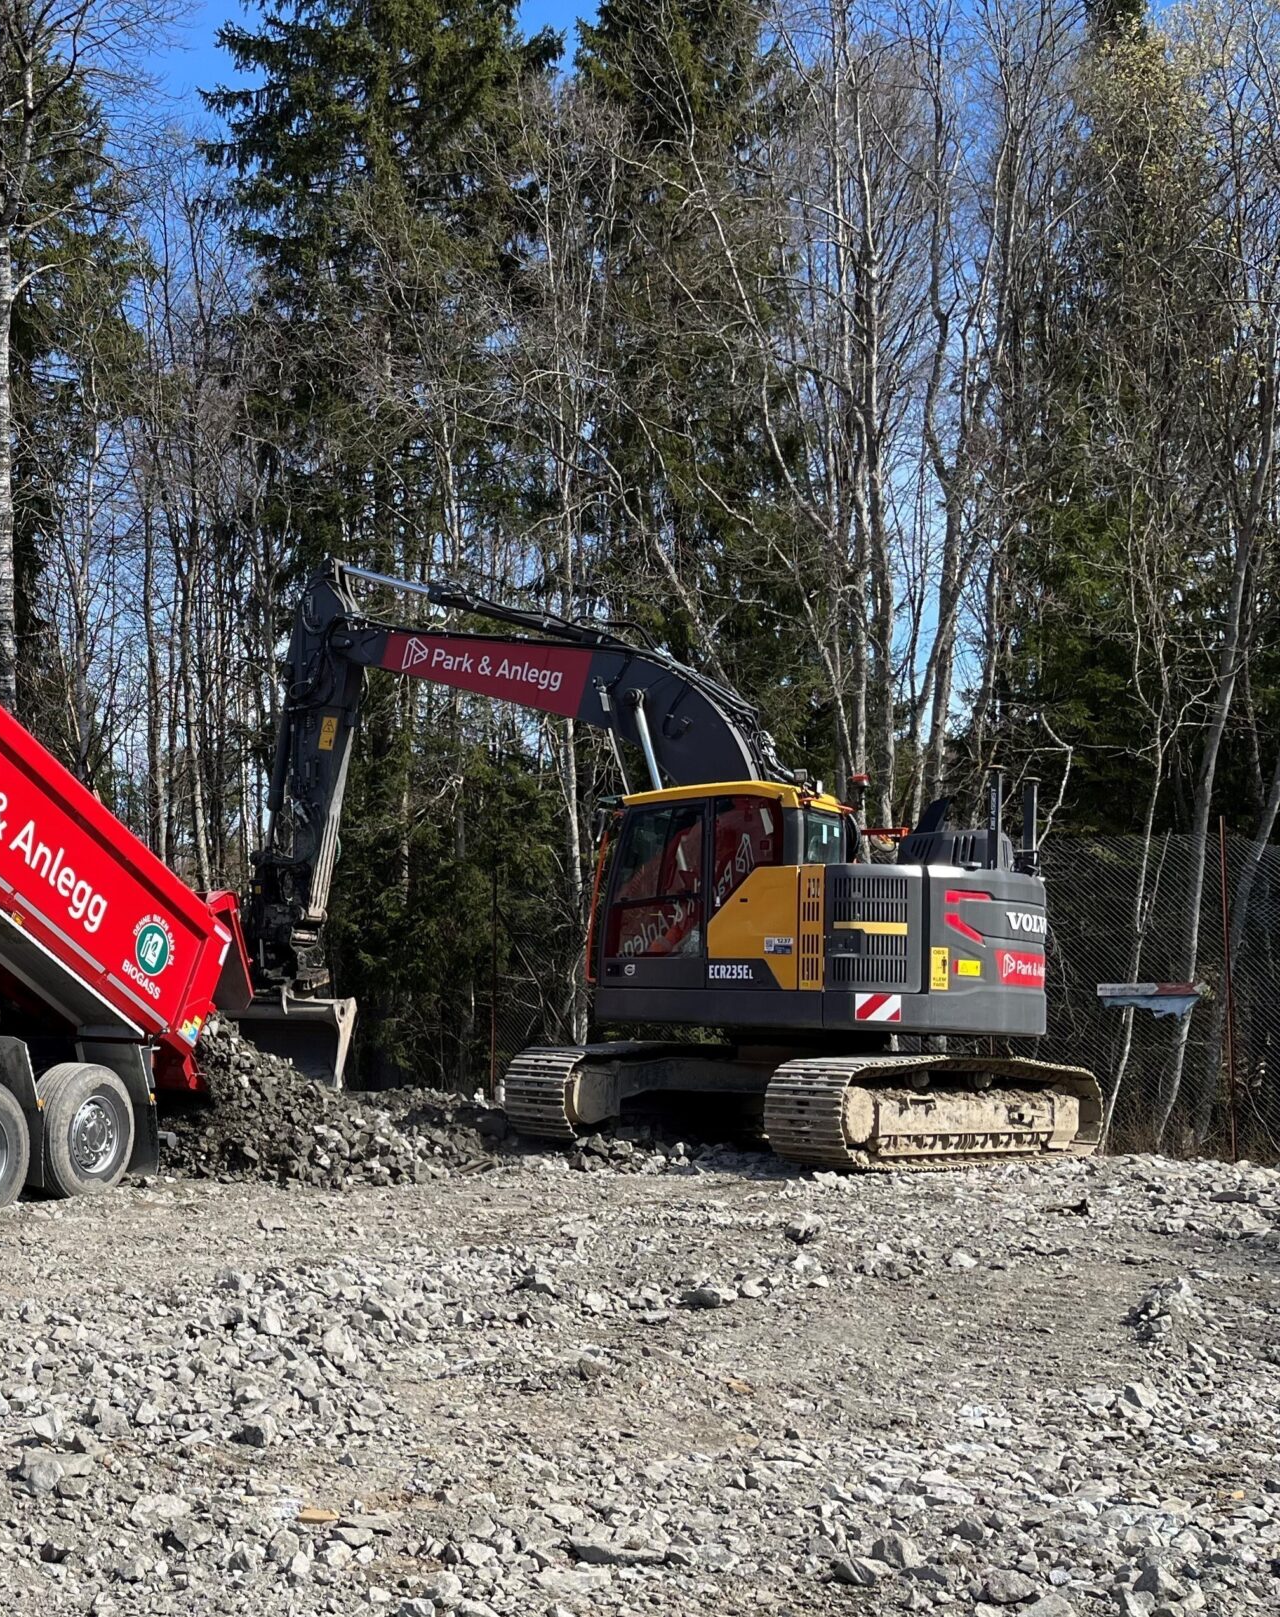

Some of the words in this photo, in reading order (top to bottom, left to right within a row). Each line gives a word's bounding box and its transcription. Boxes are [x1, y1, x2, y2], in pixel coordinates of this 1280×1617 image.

[431, 648, 474, 673] Park
[477, 655, 492, 676] &
[495, 658, 563, 692] Anlegg
[8, 819, 108, 933] Anlegg
[122, 958, 161, 1000] BIOGASS
[708, 964, 754, 980] ECR235EL
[1016, 960, 1032, 976] Park
